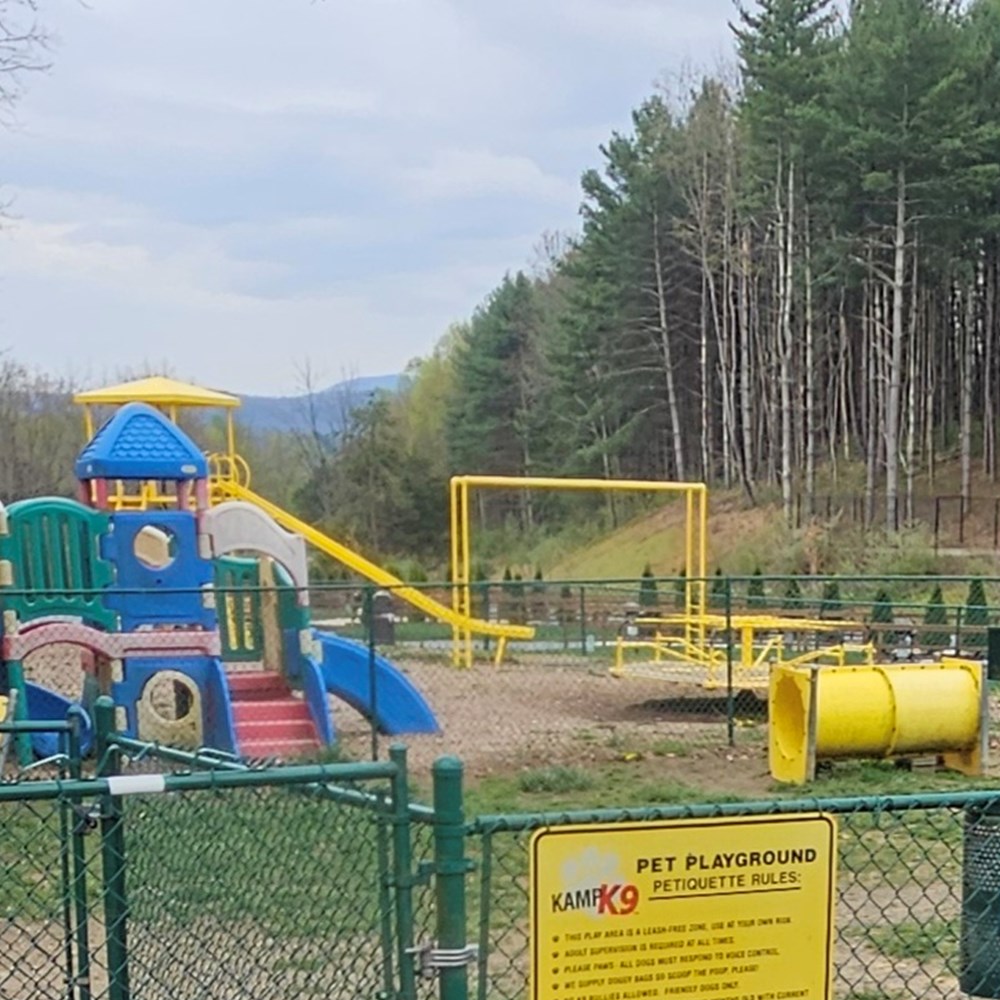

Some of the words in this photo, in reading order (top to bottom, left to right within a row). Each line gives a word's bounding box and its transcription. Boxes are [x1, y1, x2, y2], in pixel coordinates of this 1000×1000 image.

[636, 857, 677, 874] PET
[685, 848, 817, 871] PLAYGROUND
[653, 874, 745, 893] PETIQUETTE
[751, 871, 801, 886] RULES:
[584, 931, 602, 940] PLAY
[604, 929, 624, 938] AREA
[626, 928, 633, 936] IS
[687, 939, 695, 947] AT
[697, 938, 710, 946] ALL
[564, 963, 591, 973] PLEASE
[620, 960, 633, 968] ALL
[680, 953, 712, 962] RESPOND
[777, 989, 809, 1000] CURRENT
